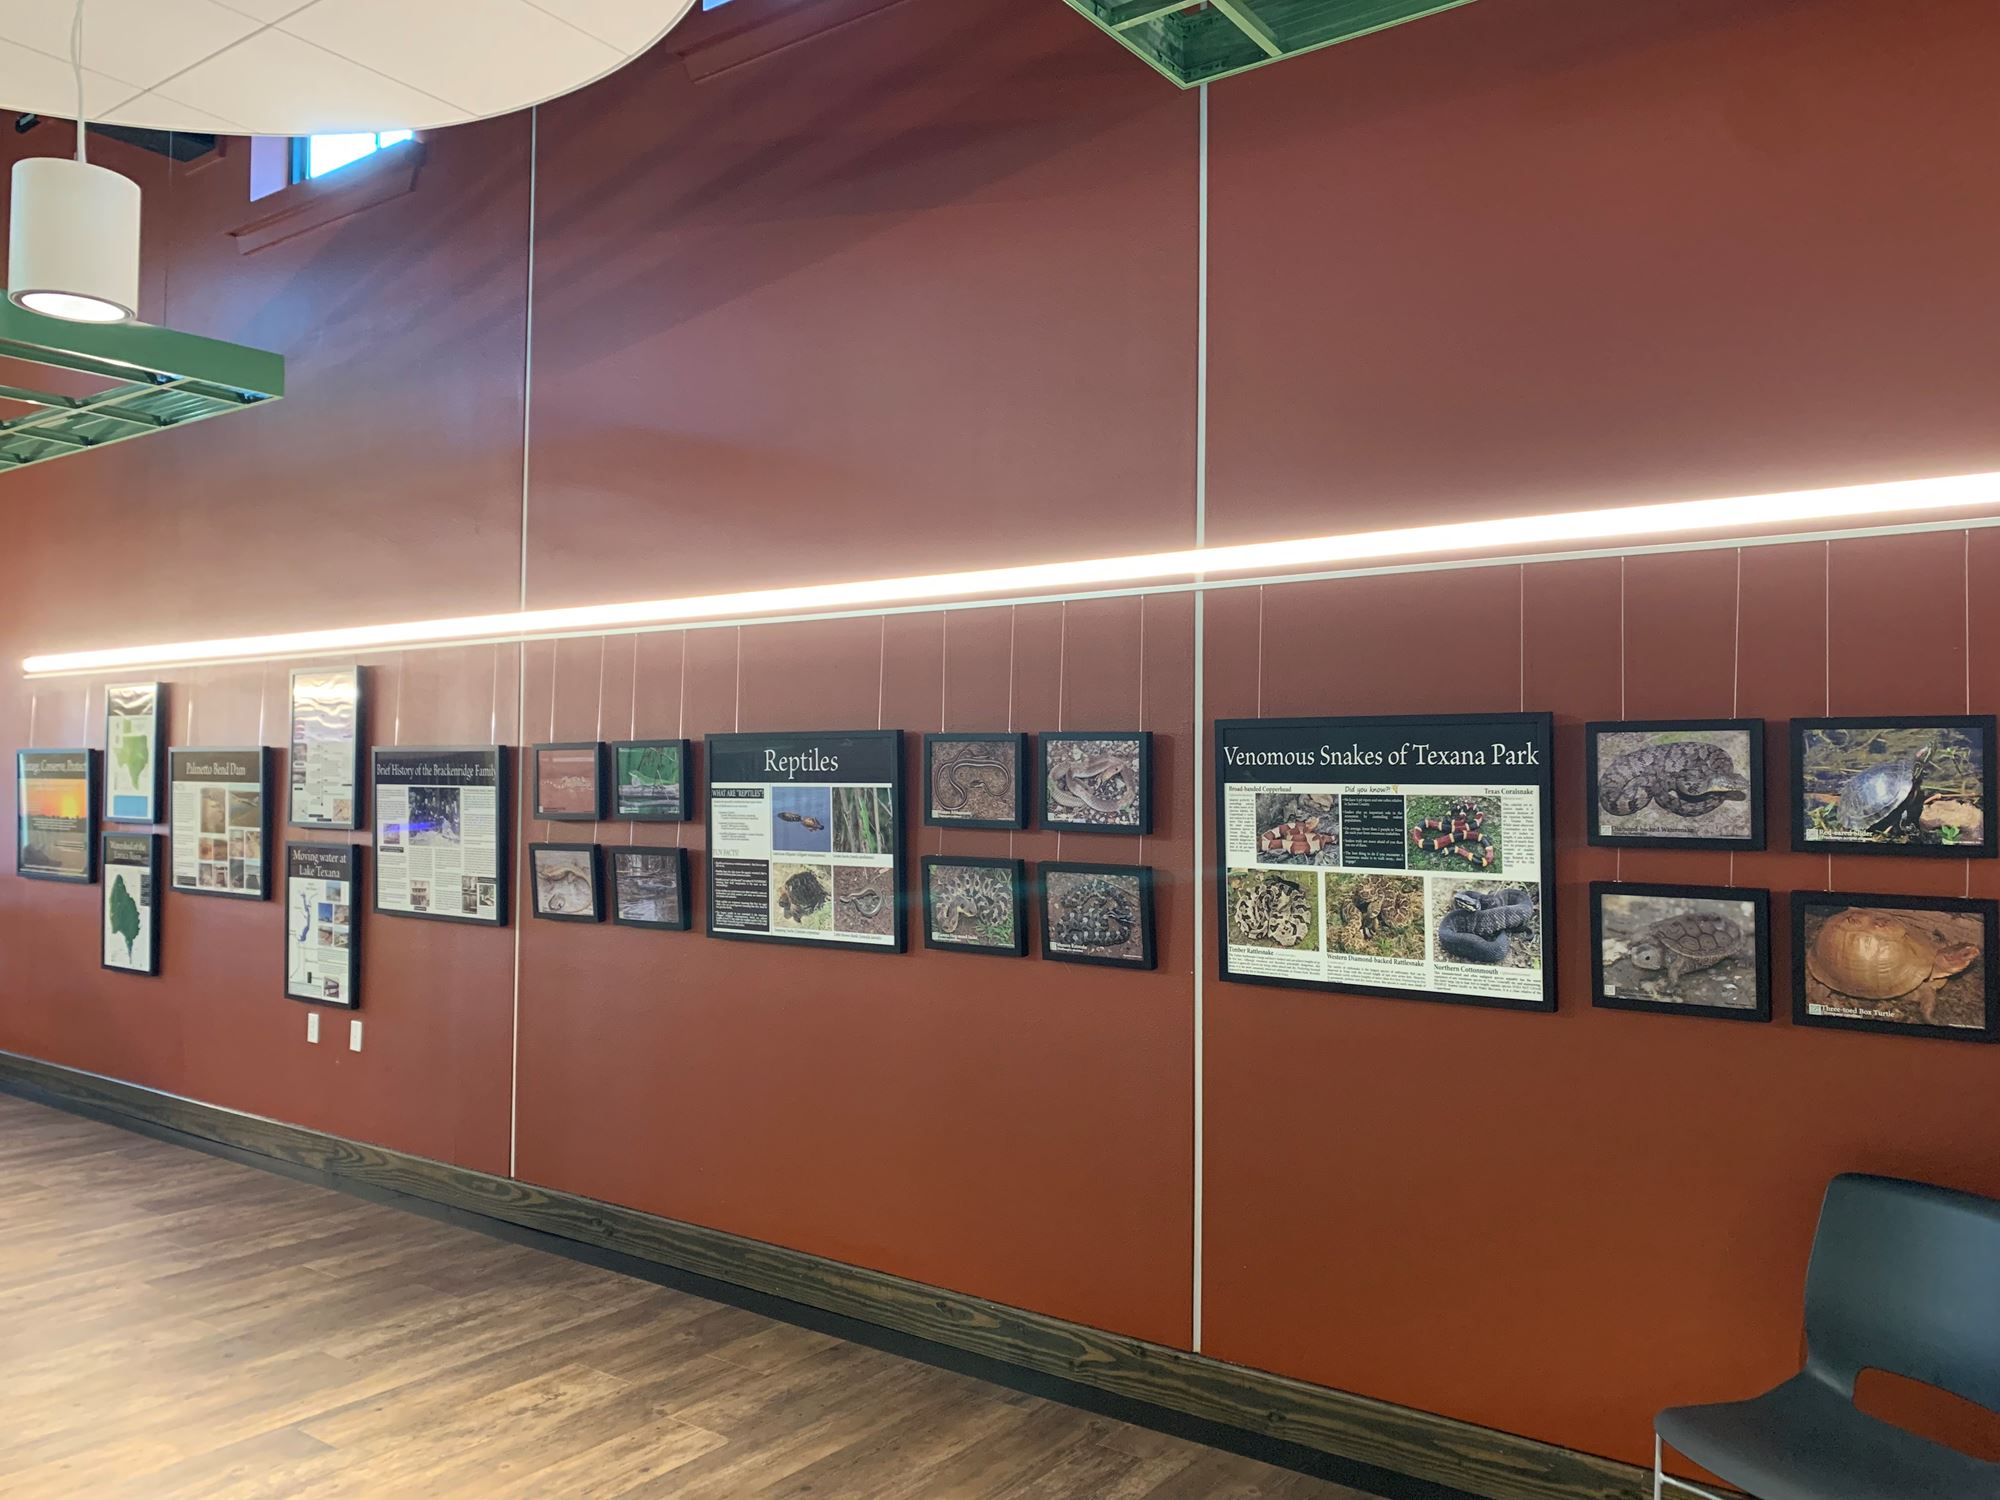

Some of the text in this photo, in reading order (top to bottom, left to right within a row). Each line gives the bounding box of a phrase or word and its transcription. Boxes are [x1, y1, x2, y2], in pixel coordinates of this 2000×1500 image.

[1223, 741, 1539, 766] Venomous Snakes of Texana Park
[186, 761, 246, 776] Palmetto Bend Dam
[763, 747, 839, 780] Reptiles
[376, 763, 496, 781] Brief History of the Brackenridge Family
[711, 789, 726, 797] WHAT
[726, 789, 736, 797] ARE
[1501, 788, 1534, 796] Coralsnake
[292, 849, 347, 866] Moving water at
[299, 864, 340, 879] Lake Texana
[1433, 964, 1499, 975] Northern Cottonmouth
[1822, 1004, 1858, 1014] Three-toed
[1858, 1006, 1872, 1015] Box
[1872, 1008, 1895, 1018] Turtle
